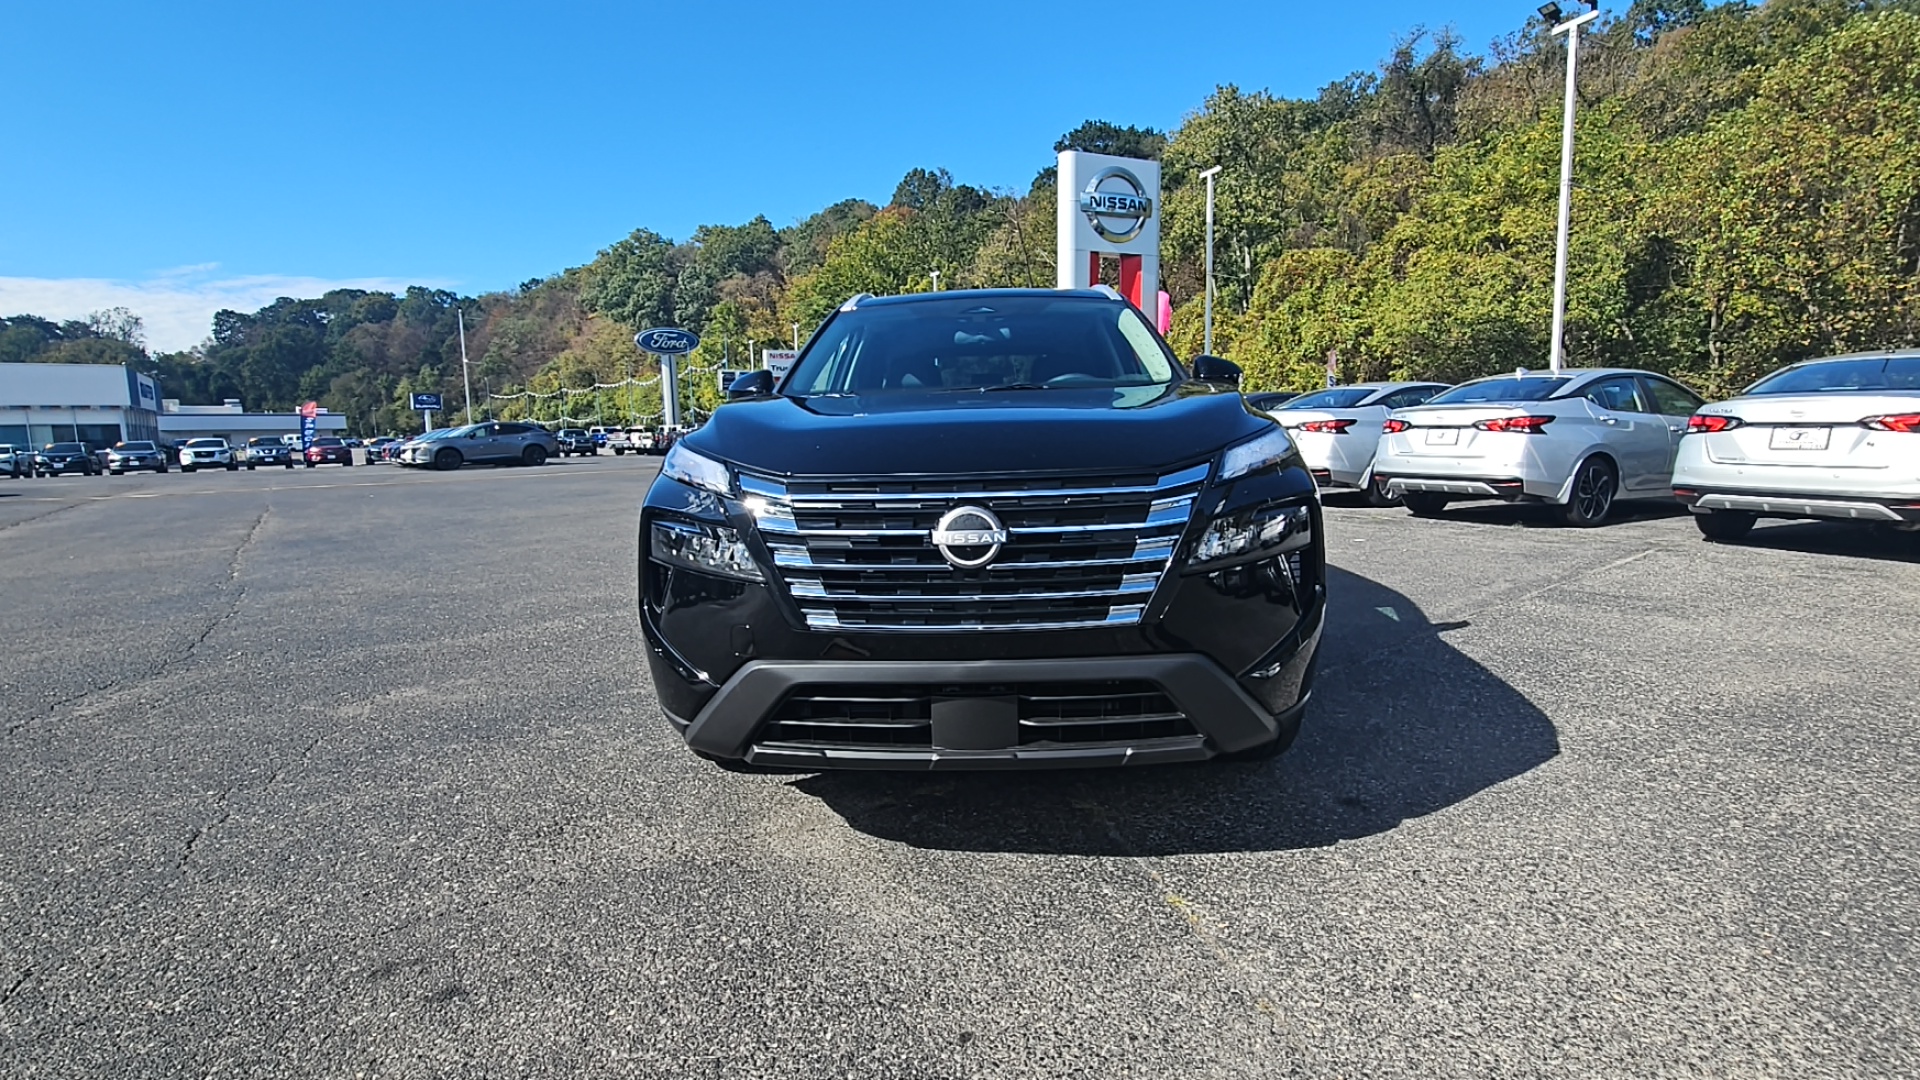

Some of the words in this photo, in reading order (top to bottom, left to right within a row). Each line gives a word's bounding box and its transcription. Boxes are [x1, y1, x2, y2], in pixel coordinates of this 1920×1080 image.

[1089, 195, 1147, 212] NISSAN
[650, 332, 688, 348] Ford
[769, 352, 796, 360] NISSA
[934, 532, 1007, 543] NISSAN
